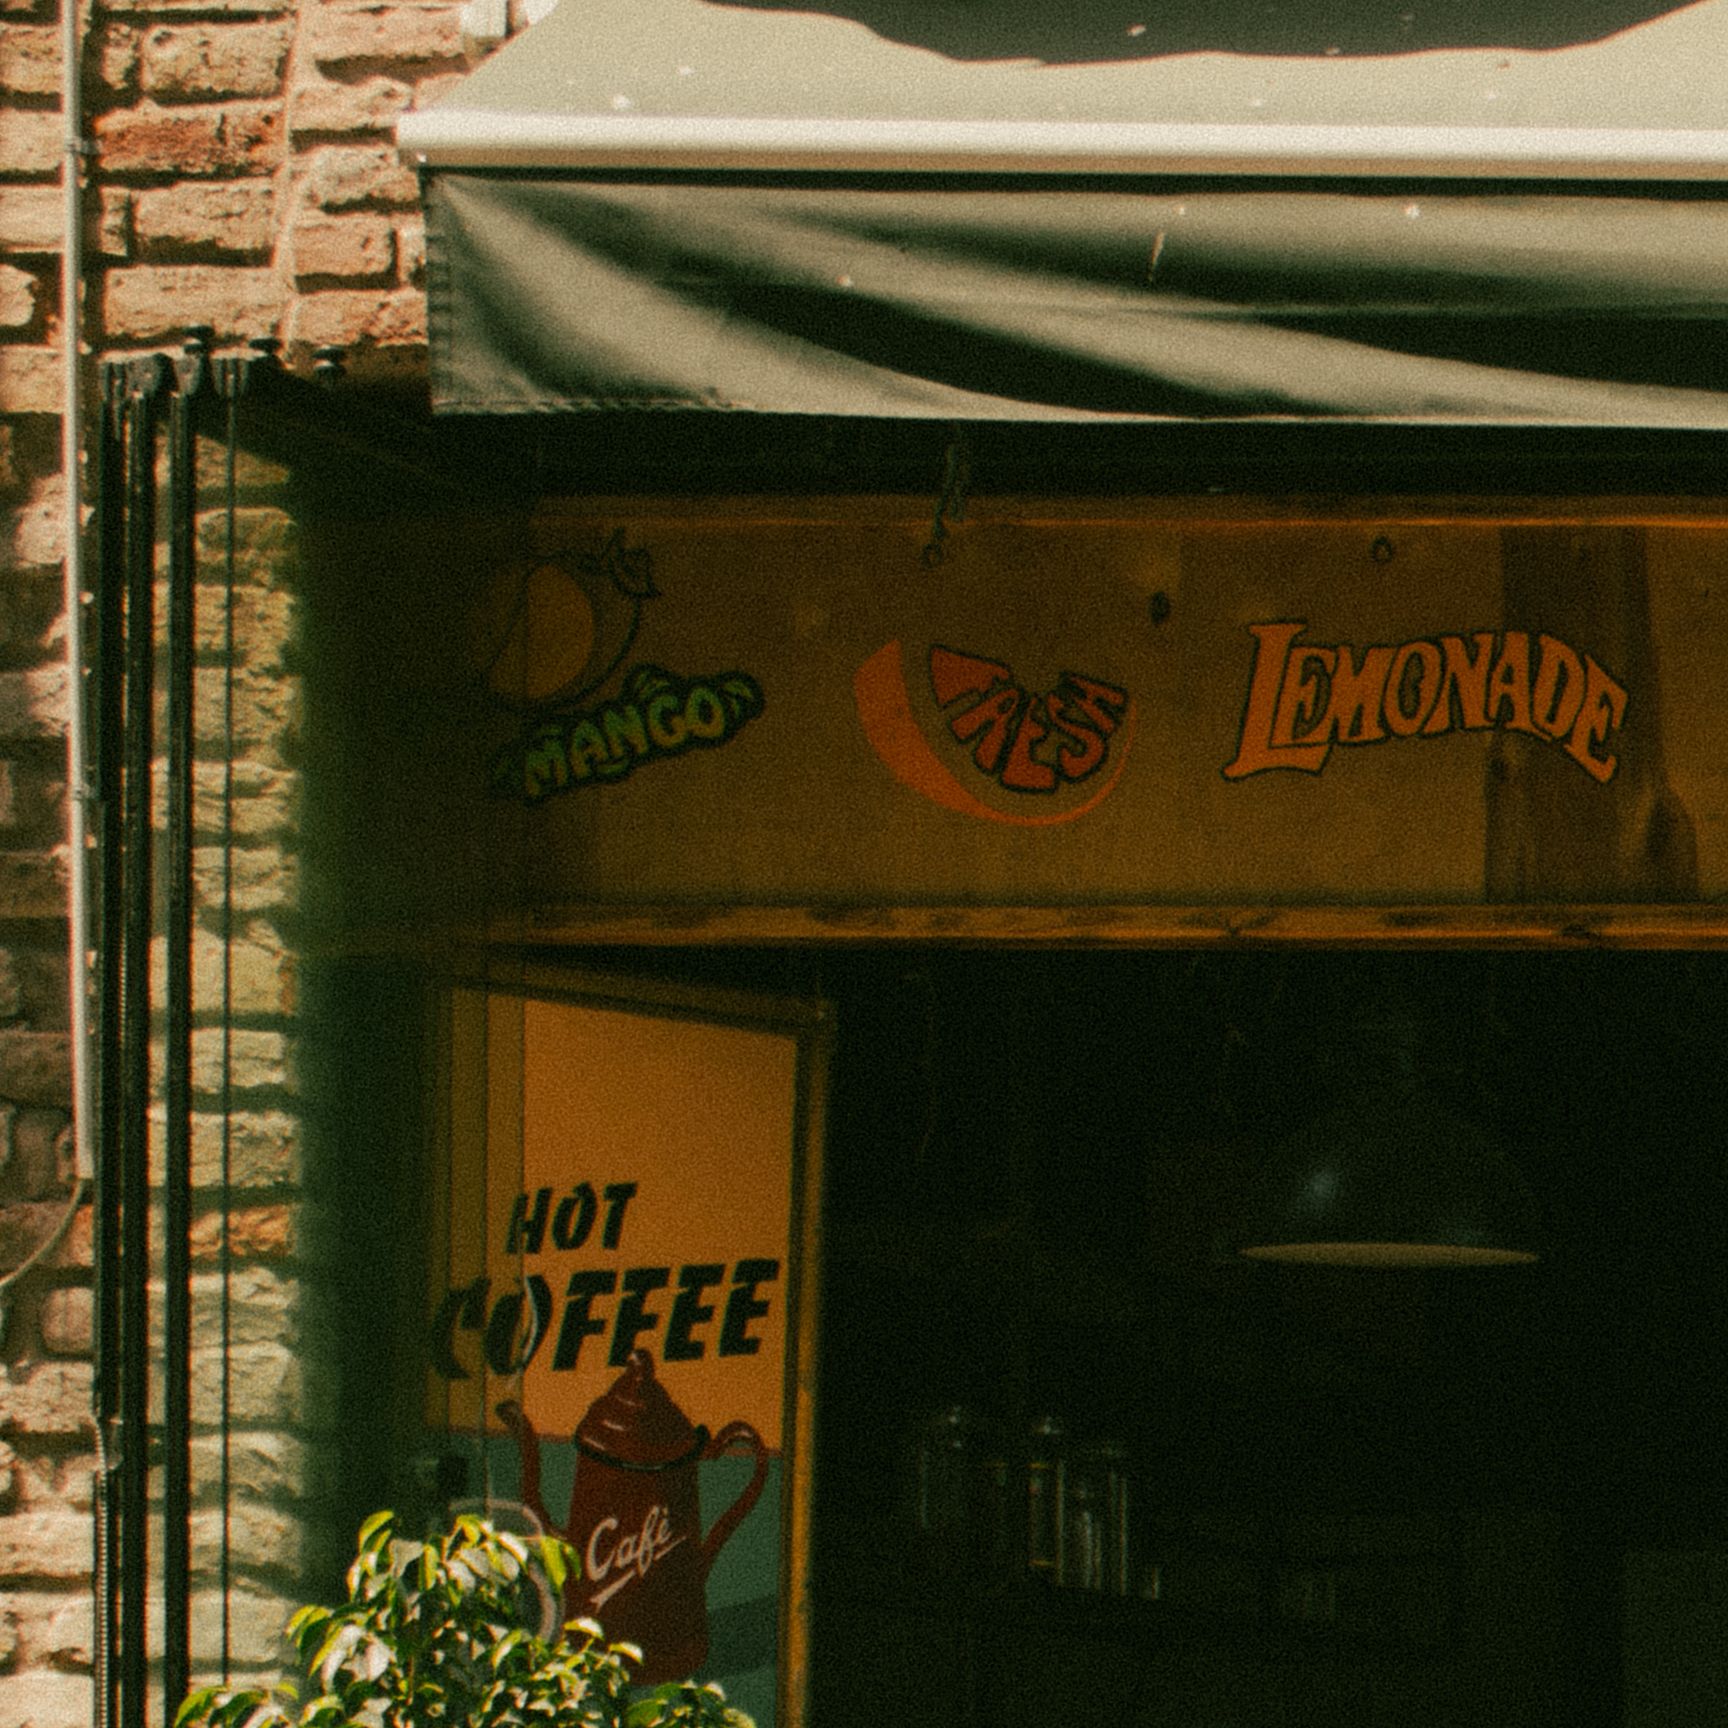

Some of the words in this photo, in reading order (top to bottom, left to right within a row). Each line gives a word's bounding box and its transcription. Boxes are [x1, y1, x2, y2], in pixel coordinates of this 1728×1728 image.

[518, 668, 755, 806] MANGO
[926, 643, 1131, 795] FRESH
[1220, 617, 1632, 785] LEMONADE
[504, 1180, 640, 1256] HOT
[431, 1257, 780, 1382] COFFEE
